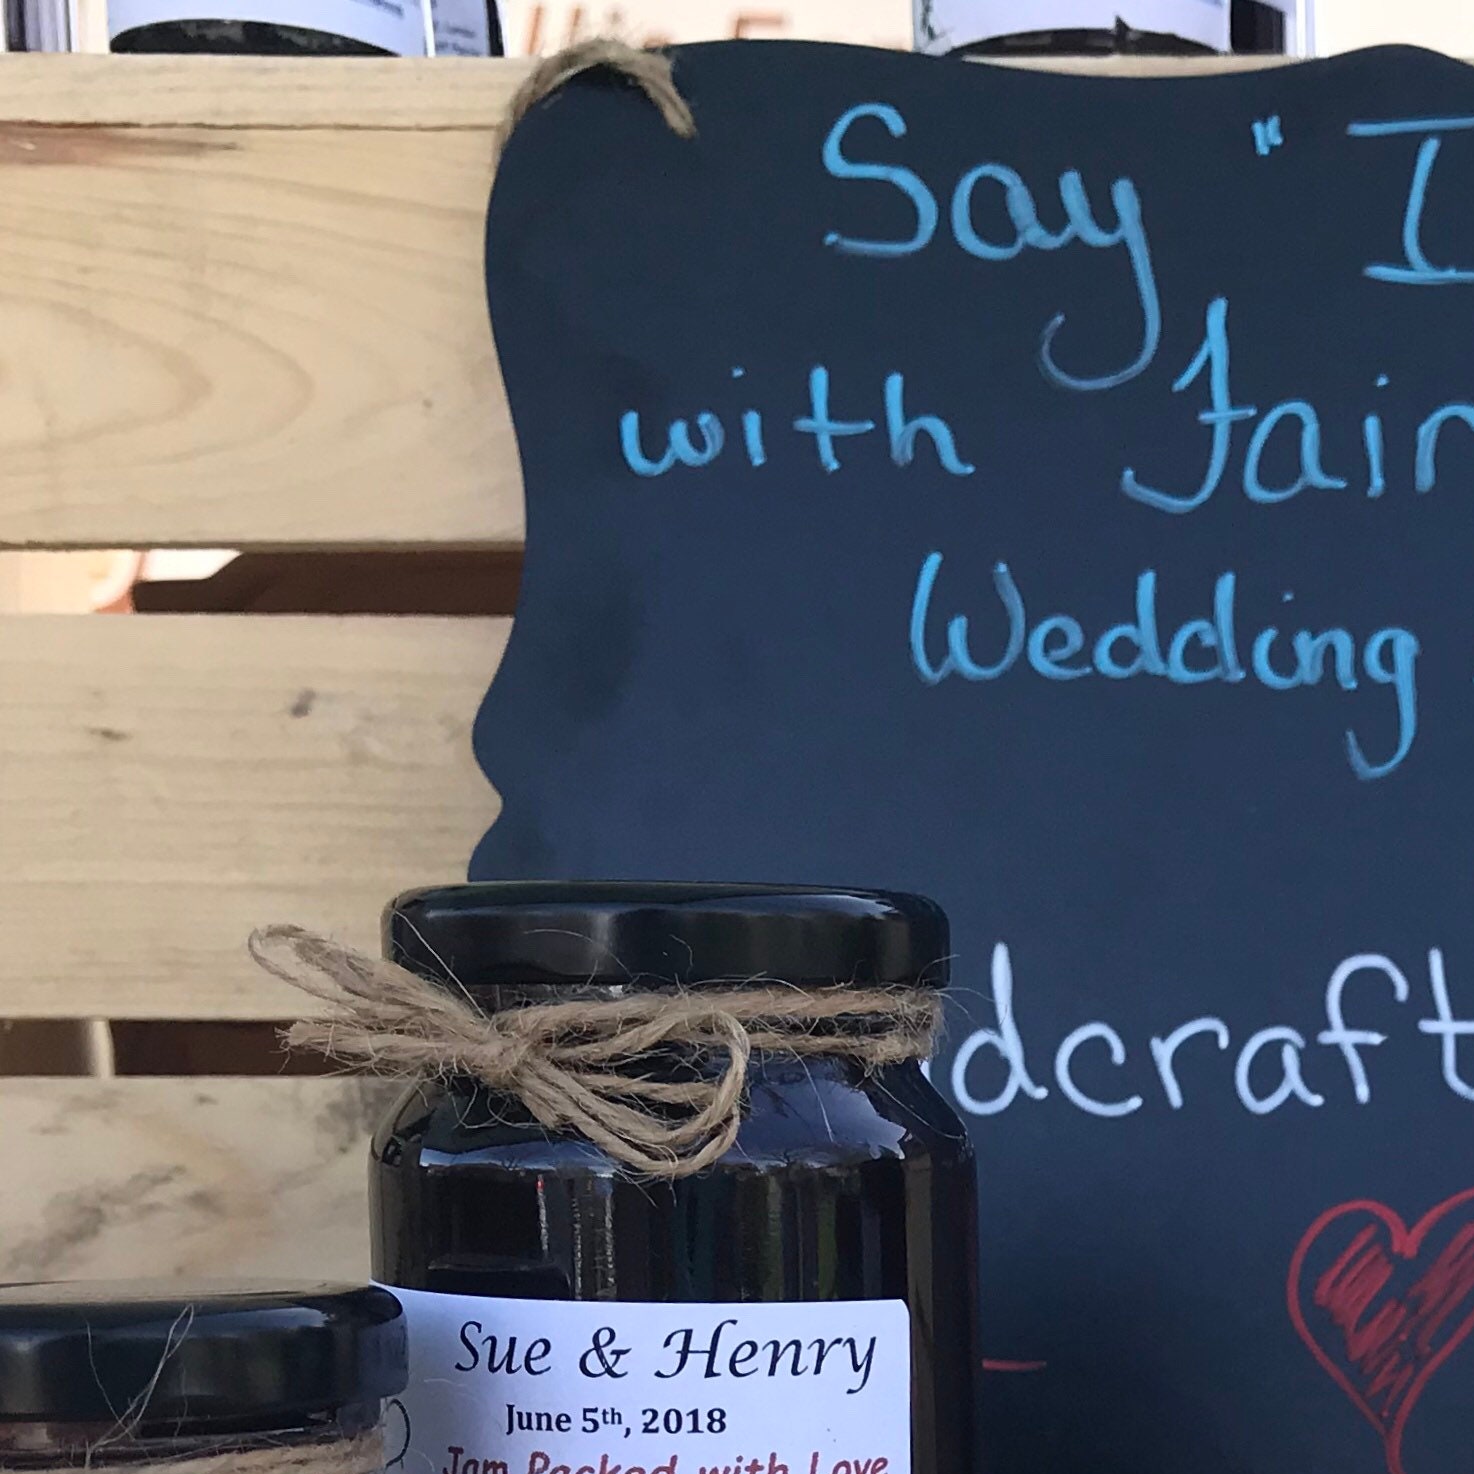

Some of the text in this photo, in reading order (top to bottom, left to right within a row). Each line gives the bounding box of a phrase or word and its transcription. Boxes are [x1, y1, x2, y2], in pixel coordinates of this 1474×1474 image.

[821, 102, 1161, 391] Say
[620, 365, 976, 476] with
[910, 551, 1419, 778] Wedding
[455, 1318, 877, 1395] Sue & Henry
[505, 1402, 727, 1439] June 5th, 2018
